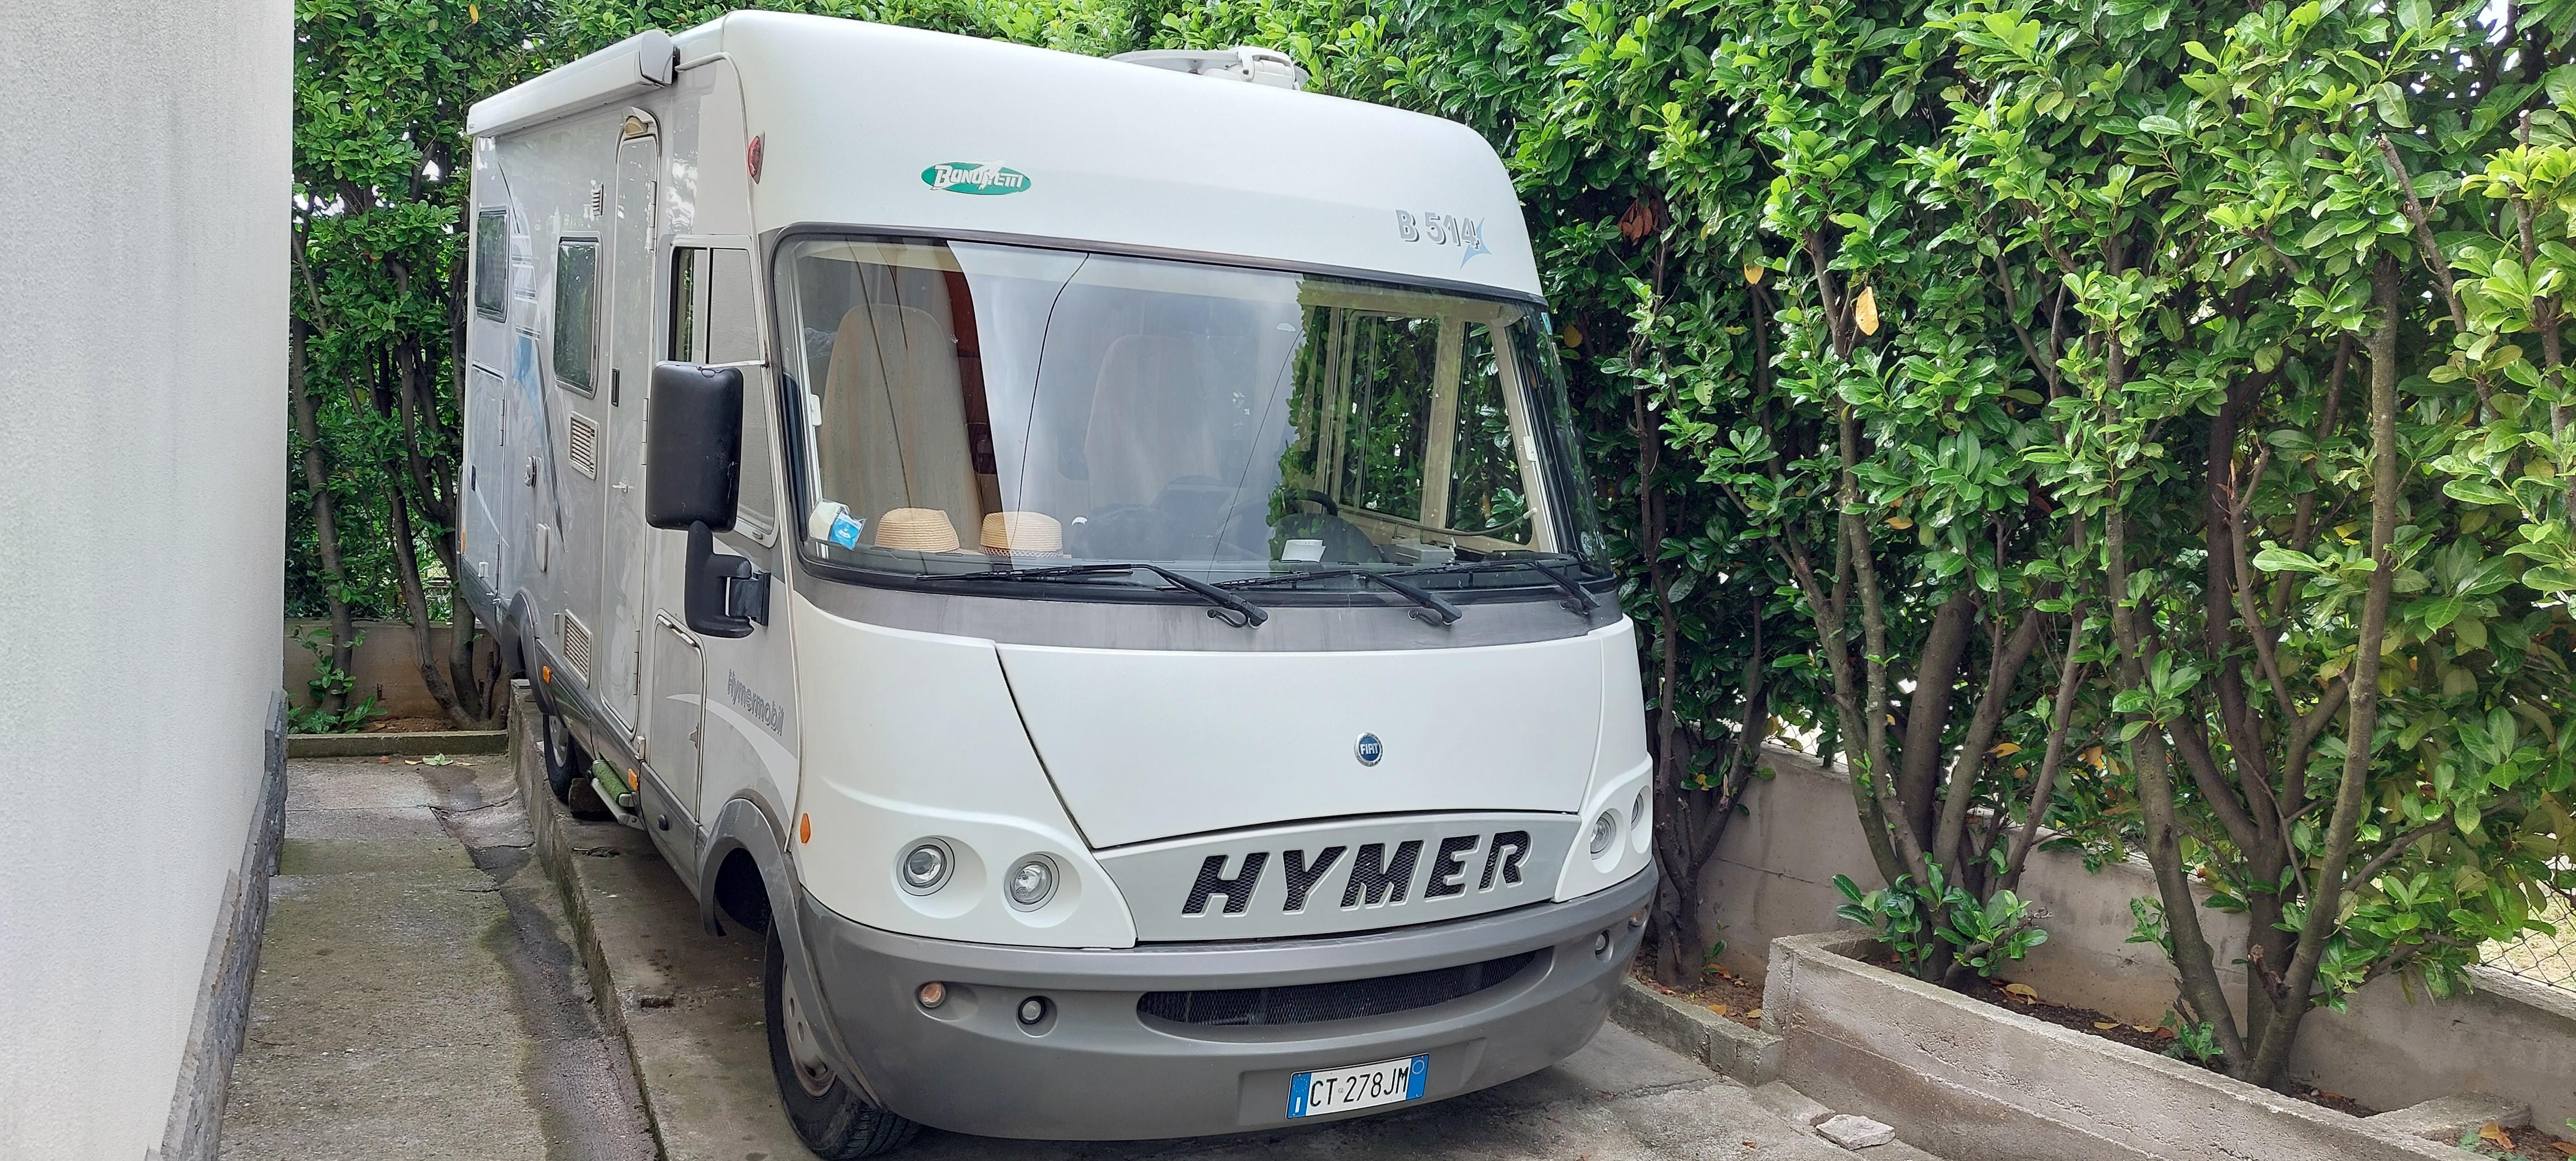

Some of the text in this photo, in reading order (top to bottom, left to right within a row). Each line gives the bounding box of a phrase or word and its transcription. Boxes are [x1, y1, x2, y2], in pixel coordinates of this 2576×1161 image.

[1395, 209, 1480, 250] B 514
[727, 668, 784, 736] Hymermobil
[1360, 743, 1378, 755] FIAT
[1182, 830, 1533, 917] HYMER
[1310, 1077, 1338, 1107] CT
[1343, 1066, 1409, 1103] 278JM
